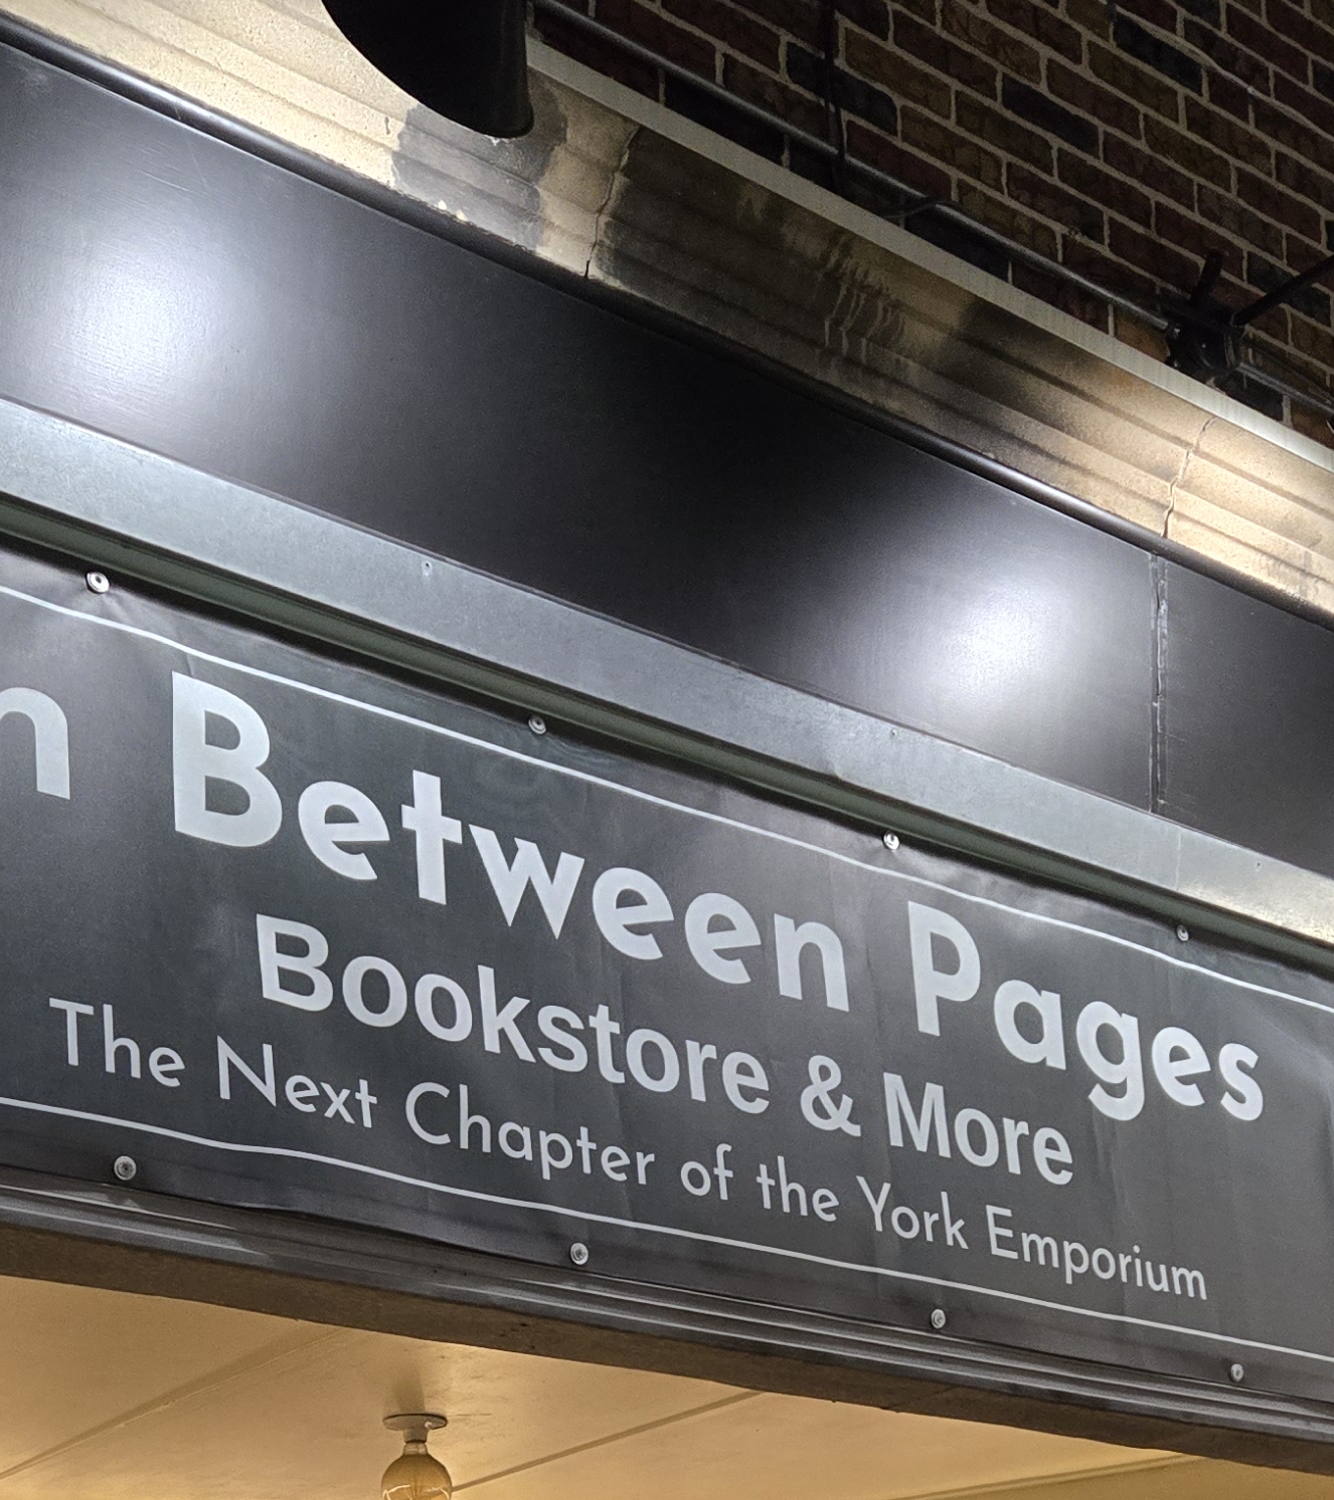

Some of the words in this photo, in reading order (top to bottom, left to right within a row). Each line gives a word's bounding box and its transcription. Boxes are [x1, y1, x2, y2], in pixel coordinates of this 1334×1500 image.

[171, 671, 850, 1013] Between
[907, 900, 1264, 1122] Pages
[48, 997, 186, 1088] The
[216, 1035, 378, 1129] Next
[405, 1081, 655, 1185] Chapter
[680, 1143, 734, 1201] of
[755, 1155, 840, 1222] the
[855, 1175, 969, 1250] York
[985, 1204, 1208, 1301] Emporium
[255, 913, 770, 1115] Bookstore
[799, 1054, 862, 1137] &
[882, 1071, 1074, 1186] More
